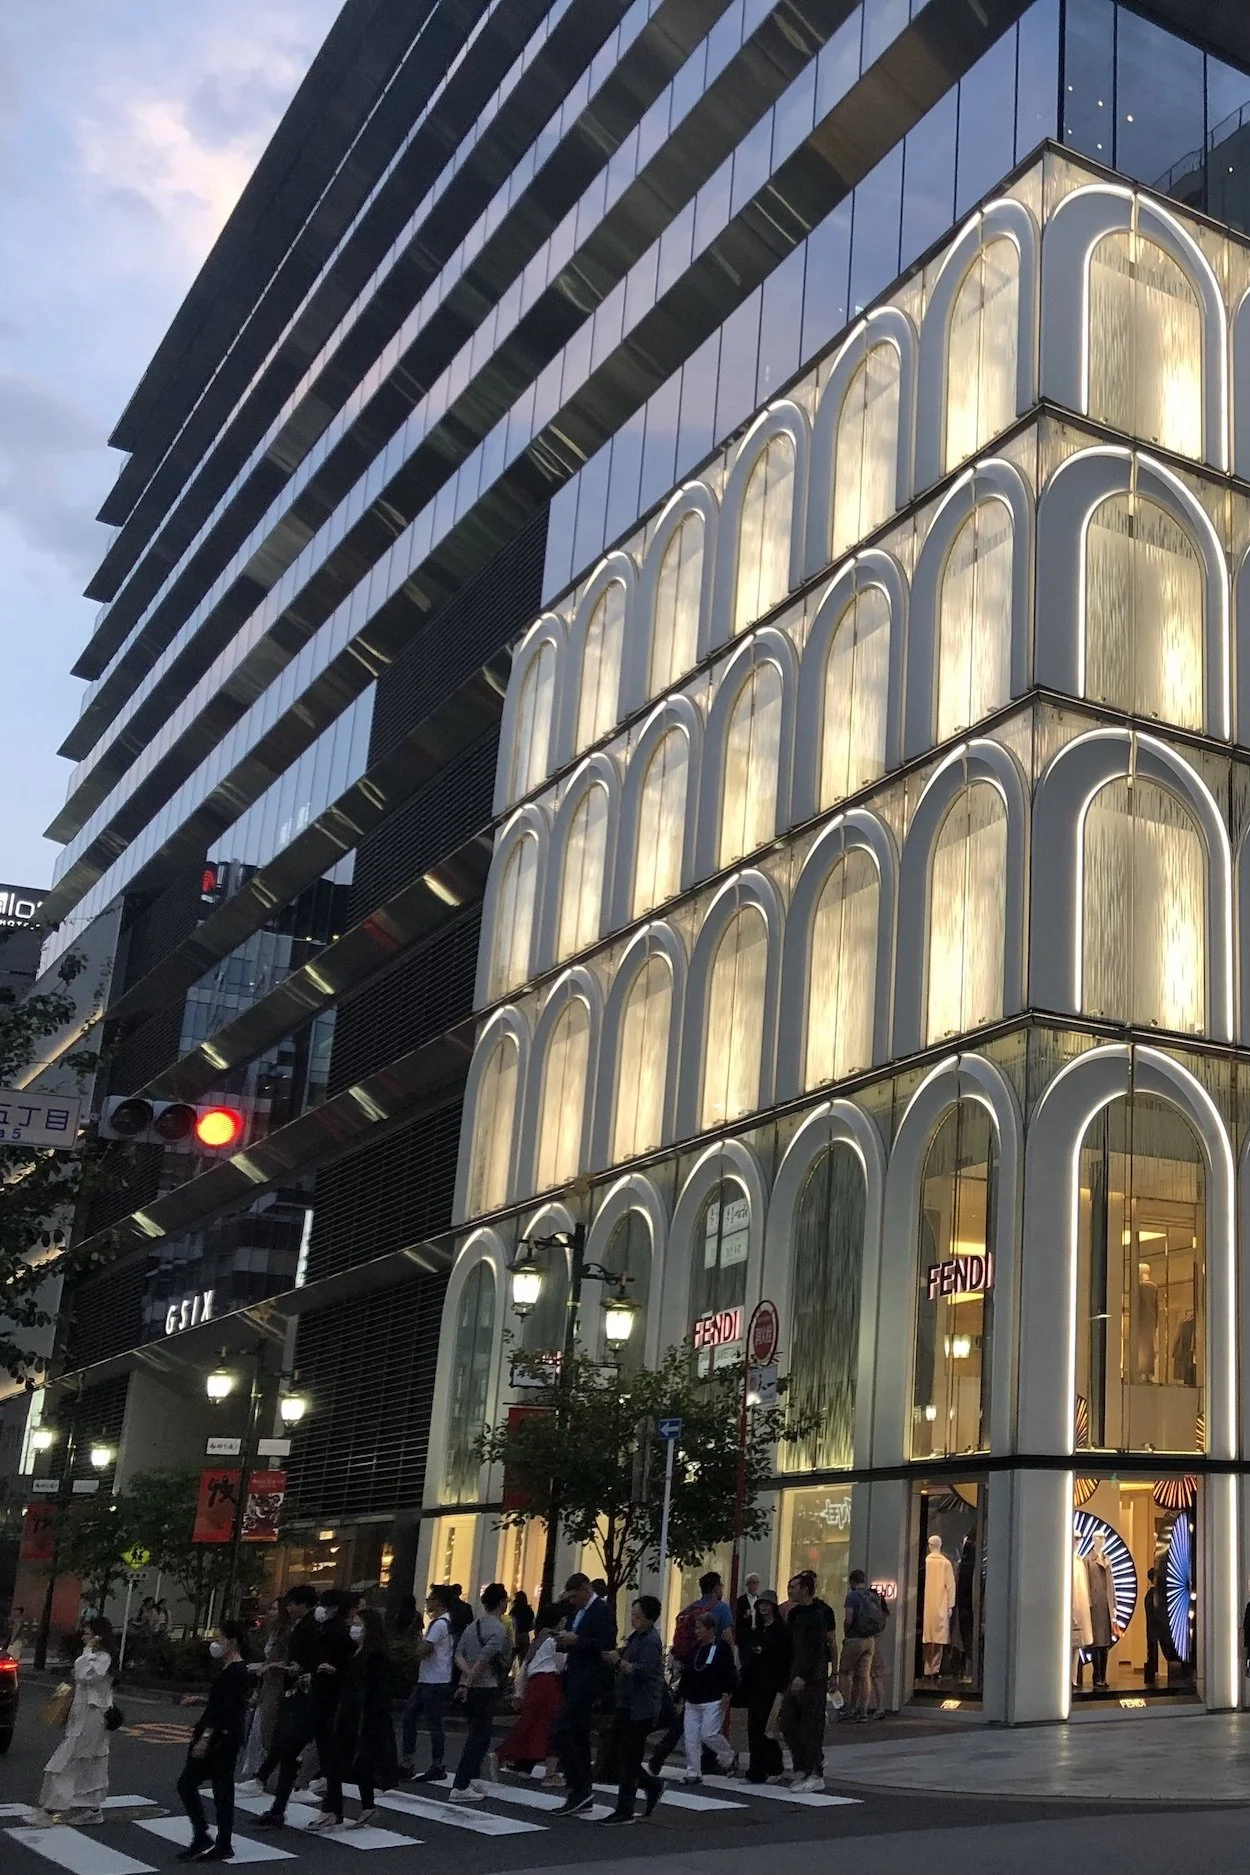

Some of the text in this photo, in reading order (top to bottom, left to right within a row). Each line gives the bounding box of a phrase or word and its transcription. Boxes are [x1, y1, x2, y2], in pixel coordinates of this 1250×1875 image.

[12, 1128, 21, 1139] 5
[927, 1252, 992, 1300] FENDI
[165, 1289, 214, 1335] GSIX
[694, 1310, 740, 1349] FENDI
[1119, 1699, 1147, 1709] FENDI
